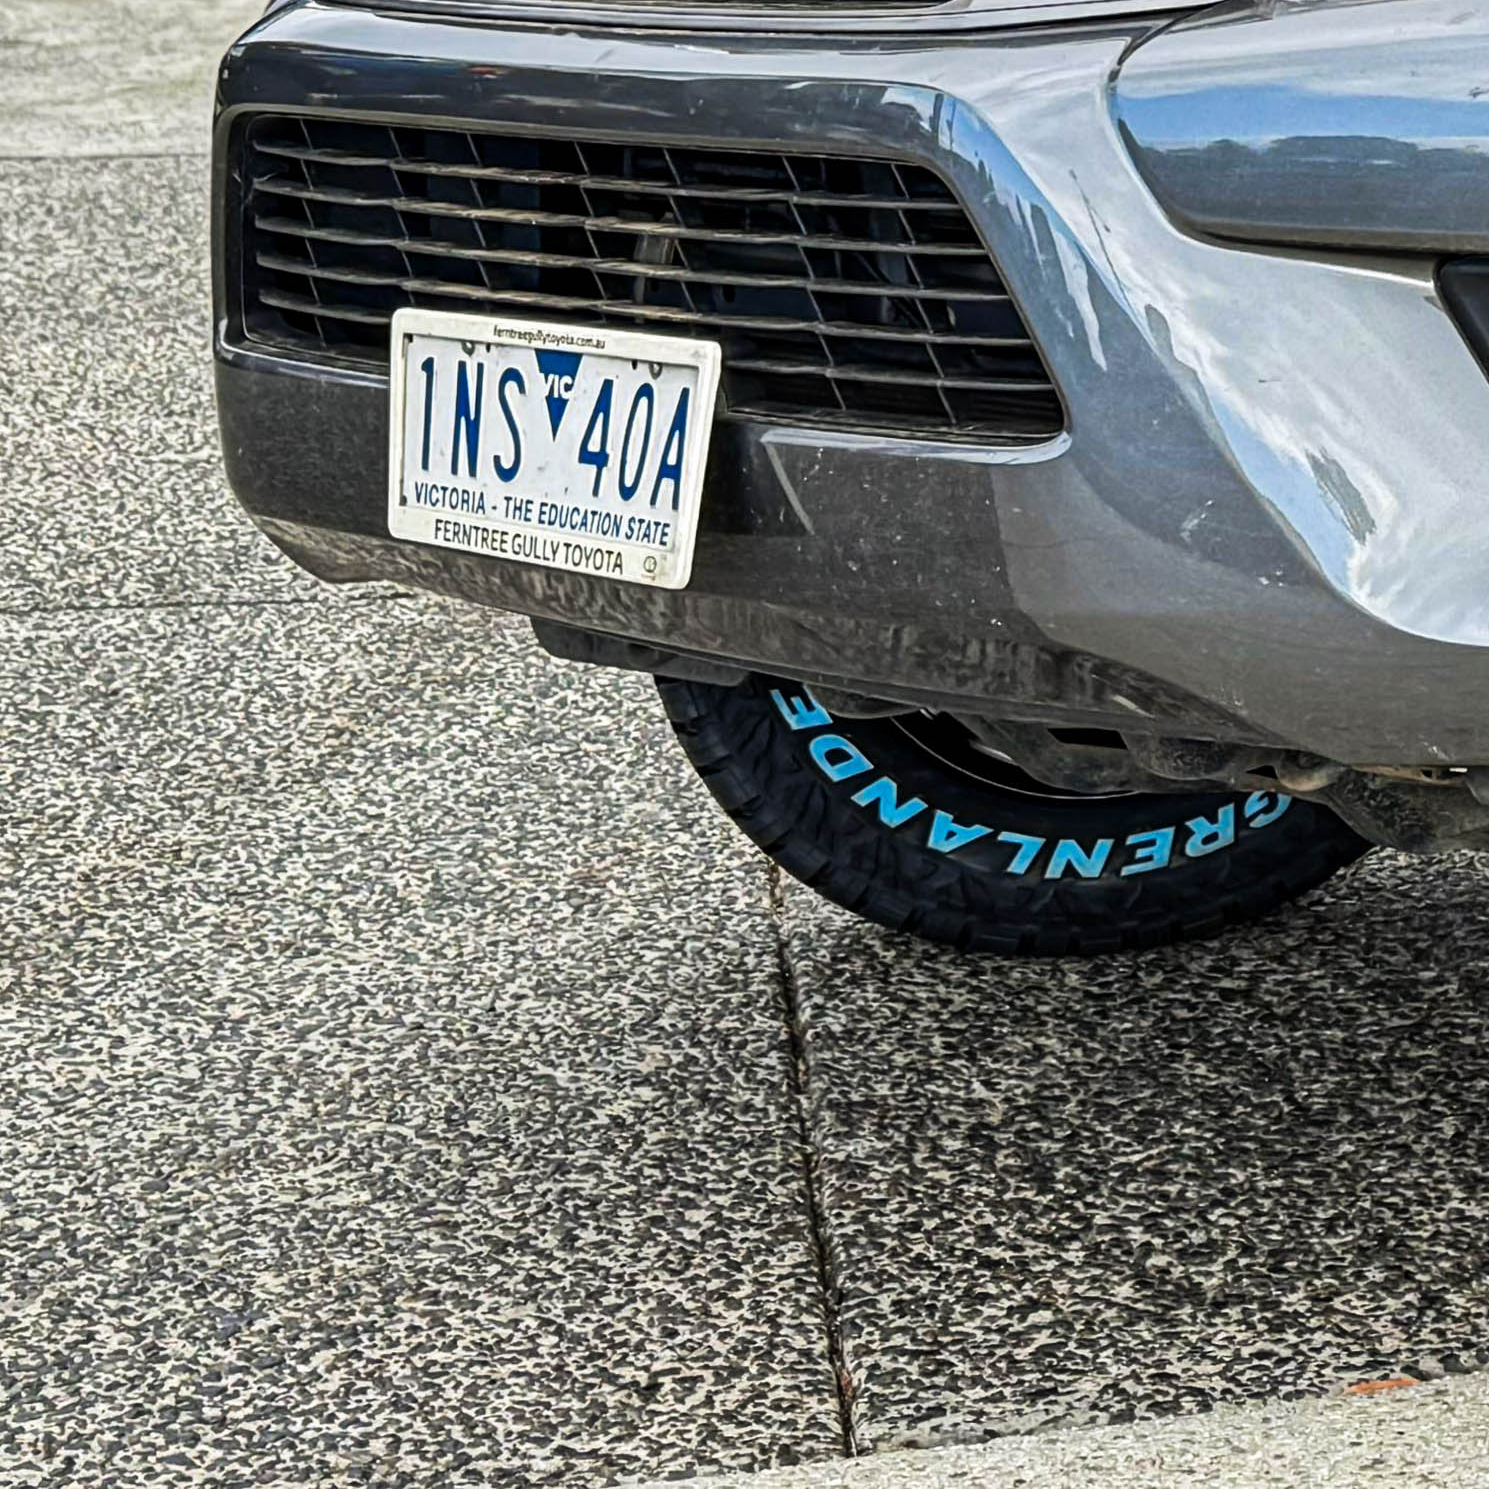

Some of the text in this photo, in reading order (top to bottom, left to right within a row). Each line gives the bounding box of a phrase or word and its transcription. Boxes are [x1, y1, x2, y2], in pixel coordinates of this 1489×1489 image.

[540, 372, 575, 400] VIC
[420, 356, 527, 484] 1NS
[414, 480, 486, 515] VICTORIA
[503, 495, 533, 524] THE
[538, 501, 624, 538] EDUCATION
[624, 517, 671, 547] STATE
[434, 518, 624, 576] FERNTREE GULLY TOYOTA
[769, 681, 1295, 879] GRENLANDE
